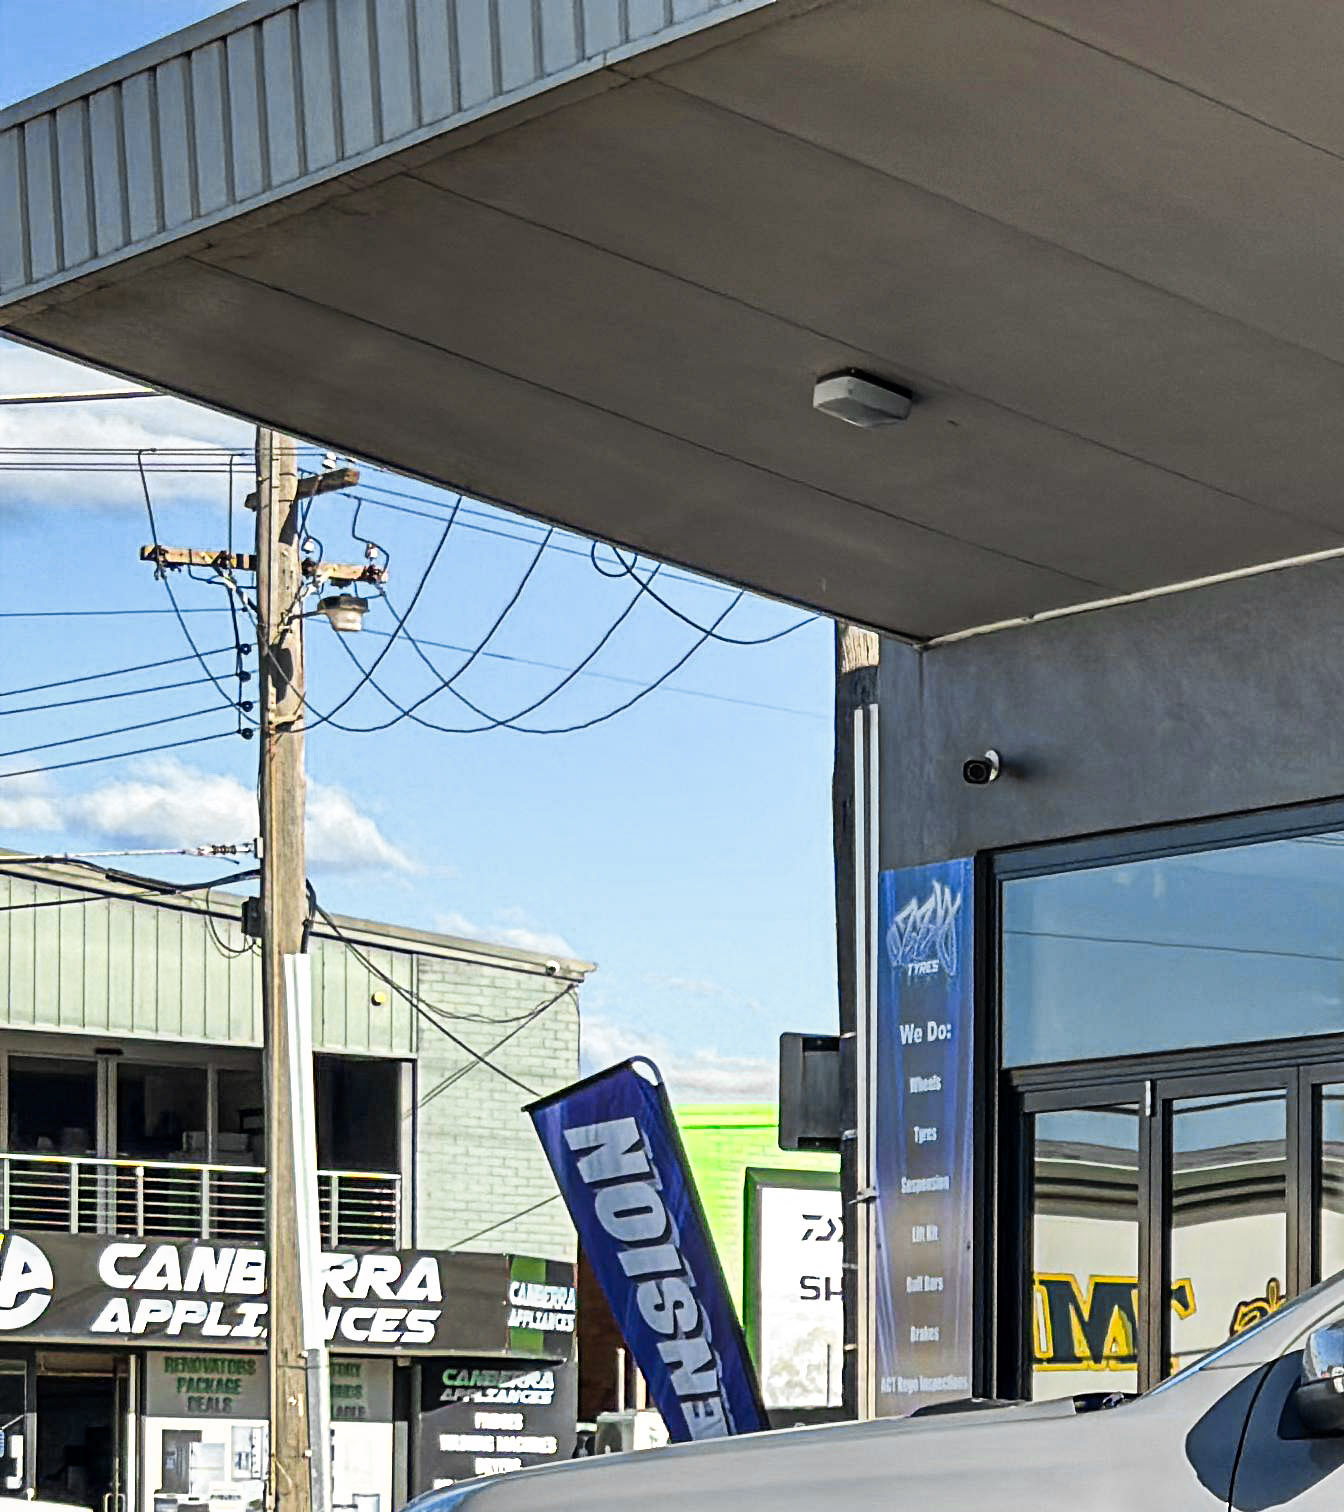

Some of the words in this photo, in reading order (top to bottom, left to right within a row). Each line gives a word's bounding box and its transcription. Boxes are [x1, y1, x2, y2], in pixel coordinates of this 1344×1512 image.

[907, 958, 940, 977] TYRES
[900, 1023, 922, 1045] We
[926, 1019, 951, 1042] Do:
[98, 1242, 443, 1302] CANBRRA
[509, 1280, 577, 1311] CANBERRA
[90, 1297, 442, 1343] APPLINCES
[507, 1307, 576, 1333] APPLIANCES
